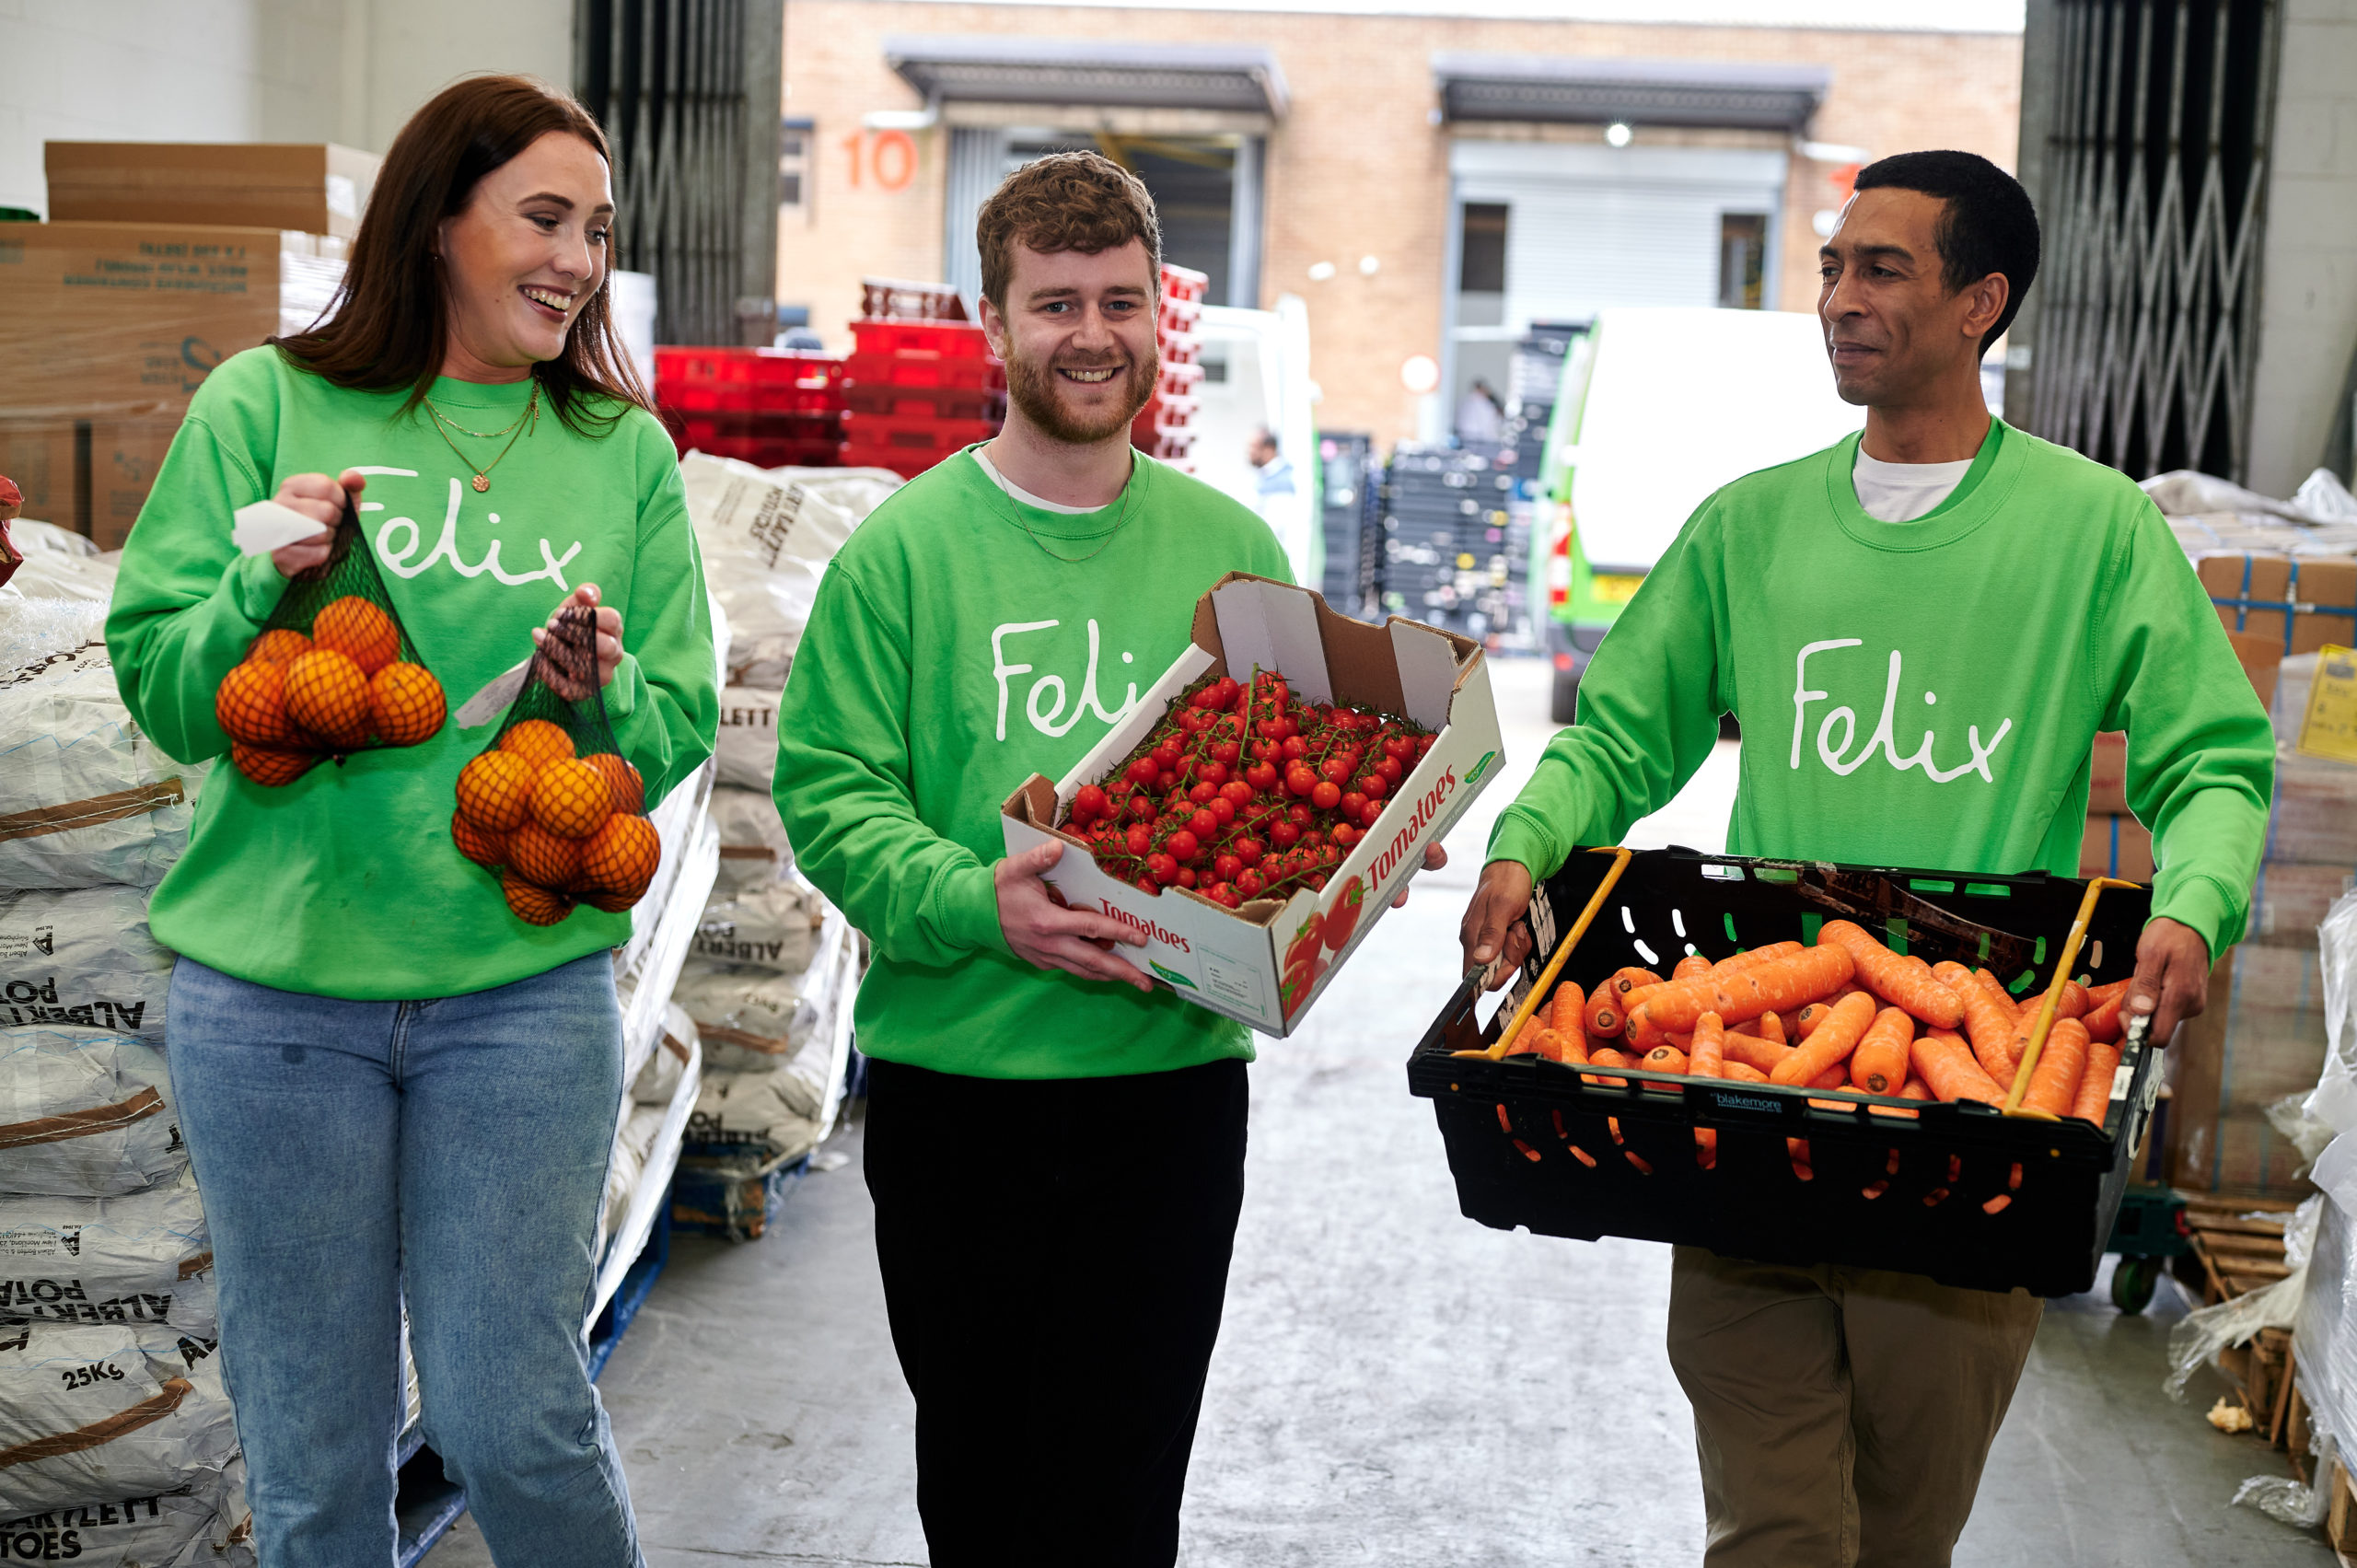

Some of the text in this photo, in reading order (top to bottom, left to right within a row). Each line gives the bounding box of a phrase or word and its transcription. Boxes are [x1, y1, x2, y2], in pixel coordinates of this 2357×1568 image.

[842, 129, 919, 194] 10
[992, 619, 1138, 741] Feli
[1790, 638, 2013, 784] Felix
[1366, 763, 1457, 892] Tomatoes
[1098, 897, 1190, 954] Tomatoes
[1716, 1092, 1782, 1109] blakemore
[62, 1360, 125, 1391] 25Kg
[0, 1495, 159, 1528] ARTLETT
[0, 1530, 83, 1560] TOES
